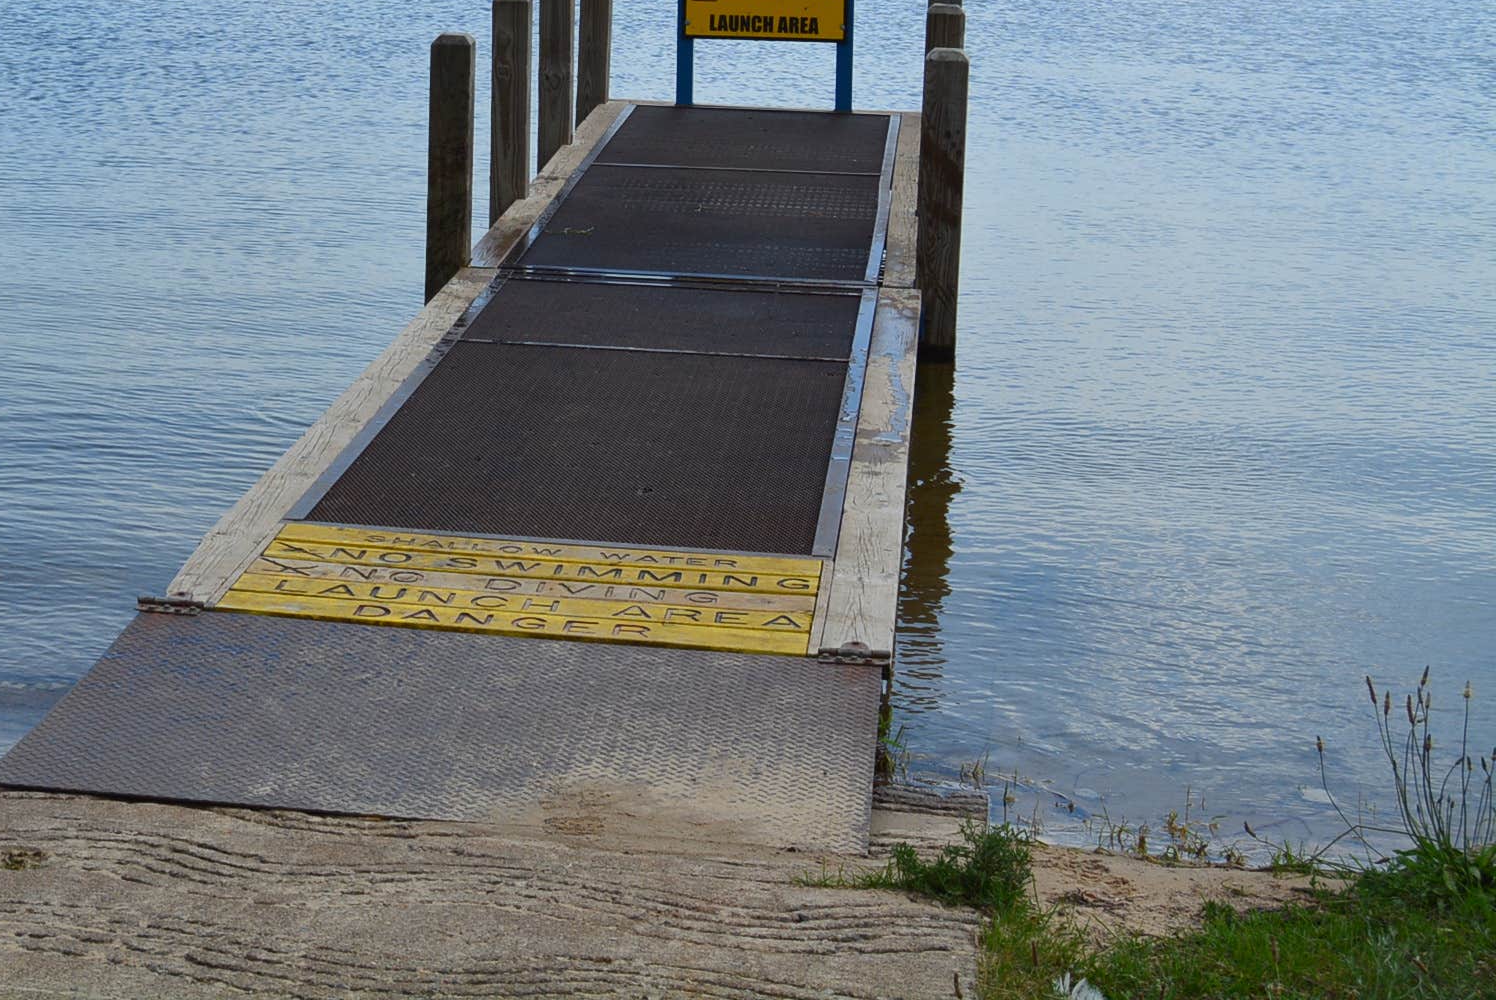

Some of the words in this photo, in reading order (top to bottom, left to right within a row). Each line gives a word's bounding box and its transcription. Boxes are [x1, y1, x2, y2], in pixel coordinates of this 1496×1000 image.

[709, 14, 774, 33] LAUNCH
[777, 16, 819, 35] AREA
[329, 547, 412, 563] NO
[445, 557, 810, 590] SWIMMING
[366, 535, 561, 556] SHALLOW
[600, 552, 738, 568] WATER
[340, 566, 424, 583] NO
[484, 578, 719, 603] DIVING
[274, 579, 560, 612] LAUNCH
[612, 604, 802, 629] AREA
[353, 604, 651, 638] DANGER
